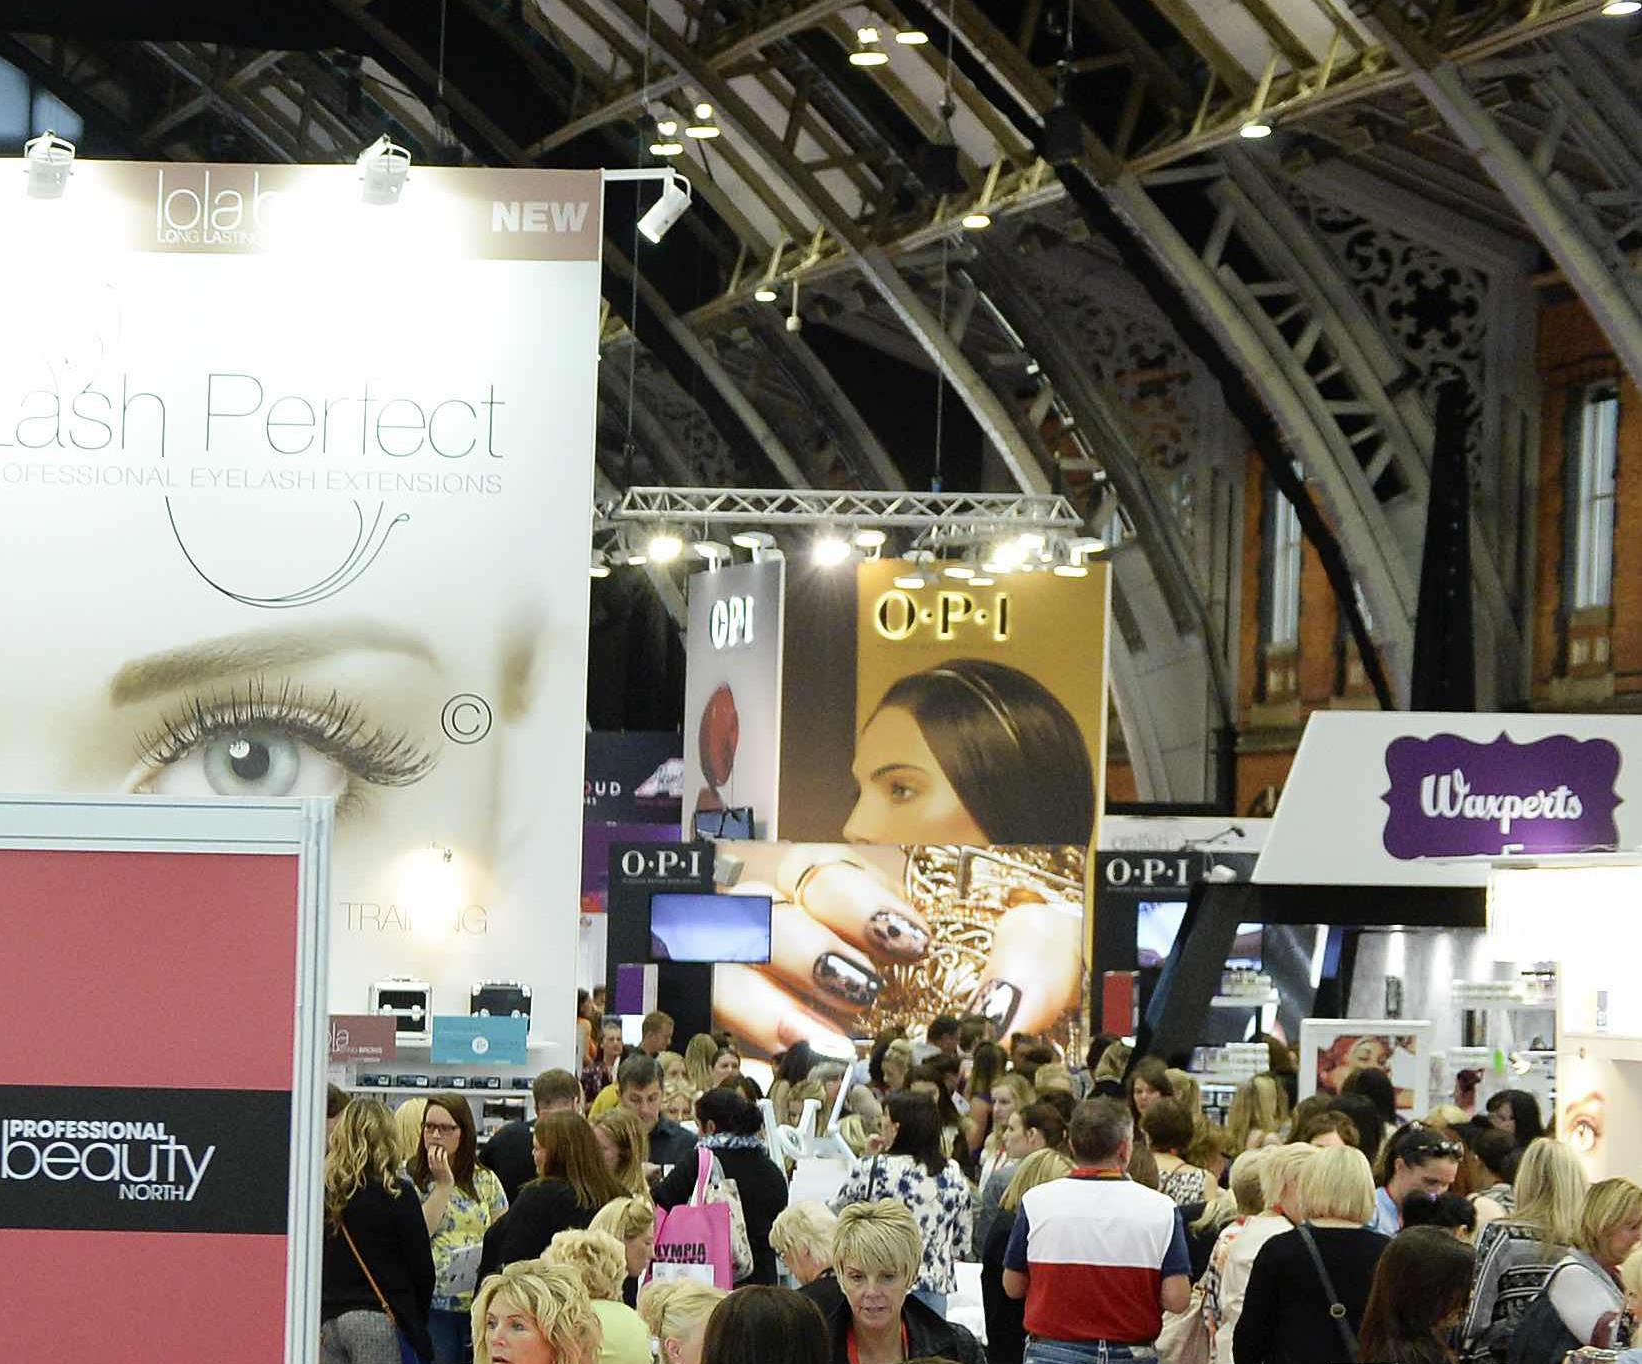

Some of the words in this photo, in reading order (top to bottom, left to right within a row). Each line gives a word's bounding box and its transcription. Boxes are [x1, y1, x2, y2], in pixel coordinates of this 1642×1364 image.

[156, 169, 244, 231] lola
[492, 202, 589, 232] NEW
[206, 370, 506, 459] Perfect
[190, 467, 315, 490] EYELASH
[326, 470, 502, 494] EXTENSIONS
[1420, 768, 1584, 835] Waxperts
[9, 1120, 169, 1140] PROFESSIONAL
[1, 1119, 216, 1201] beauty
[119, 1184, 184, 1201] NORTH
